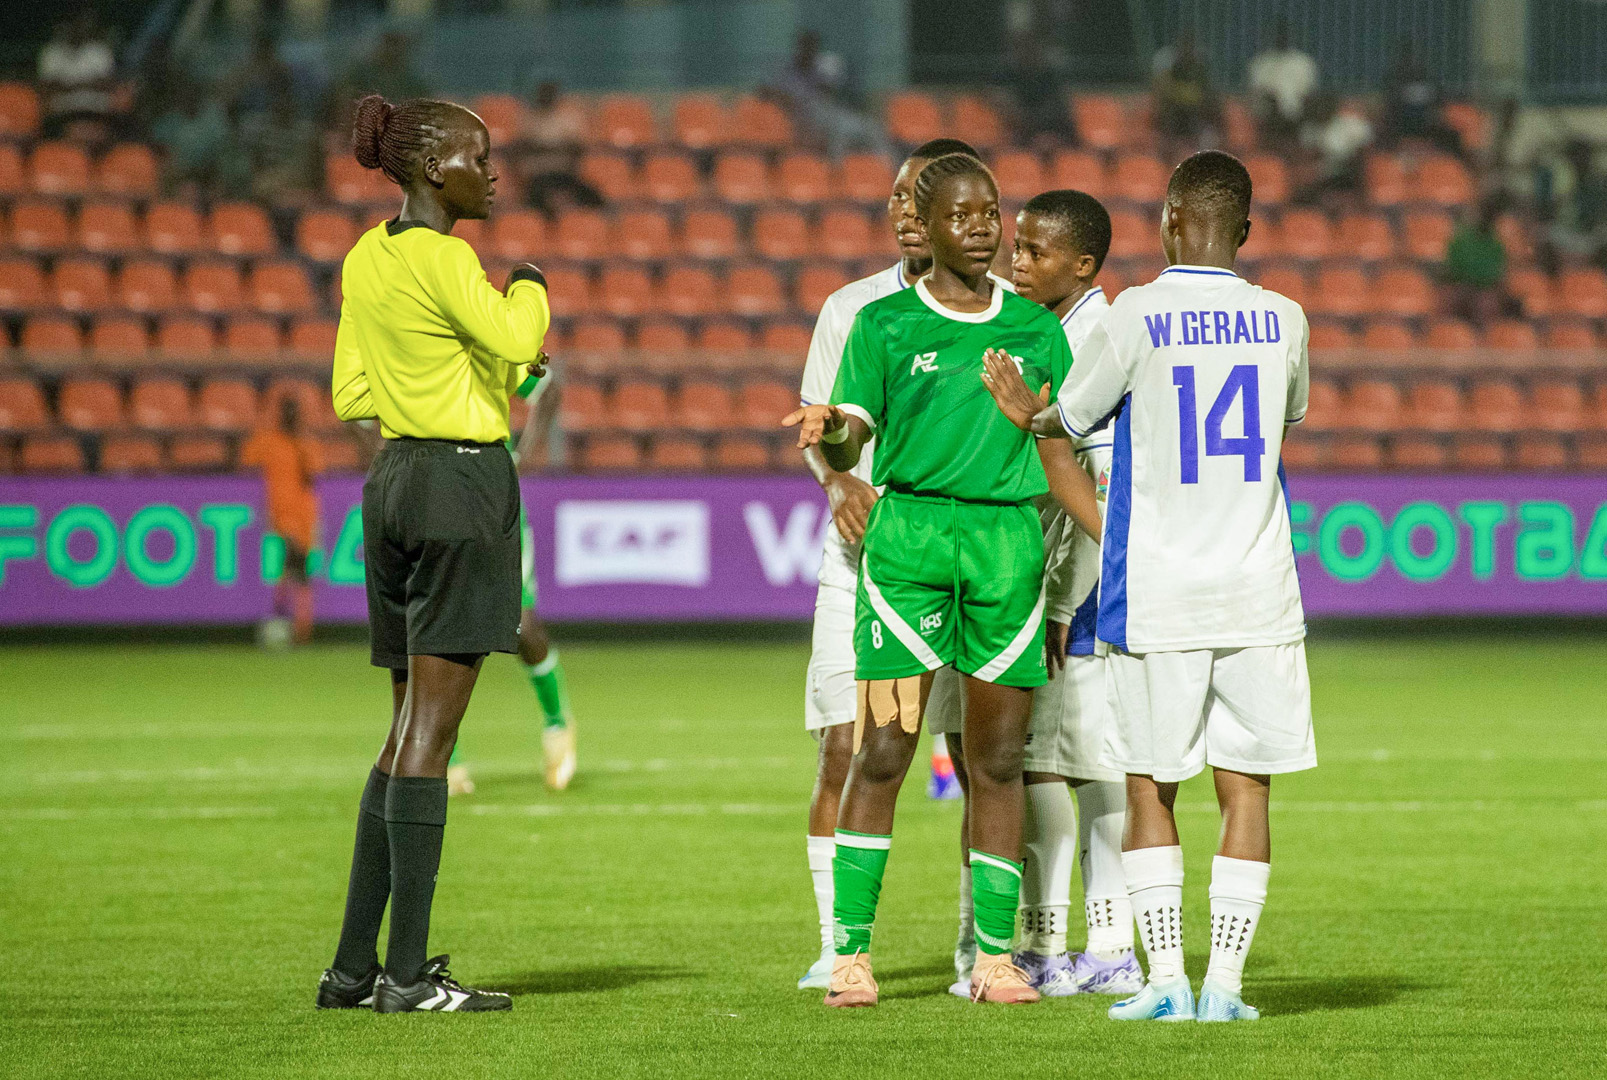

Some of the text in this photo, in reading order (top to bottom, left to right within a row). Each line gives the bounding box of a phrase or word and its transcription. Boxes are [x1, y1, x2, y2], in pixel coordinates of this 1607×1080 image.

[1144, 309, 1281, 348] W.GERALD
[1172, 364, 1266, 484] 14
[871, 620, 884, 649] 8
